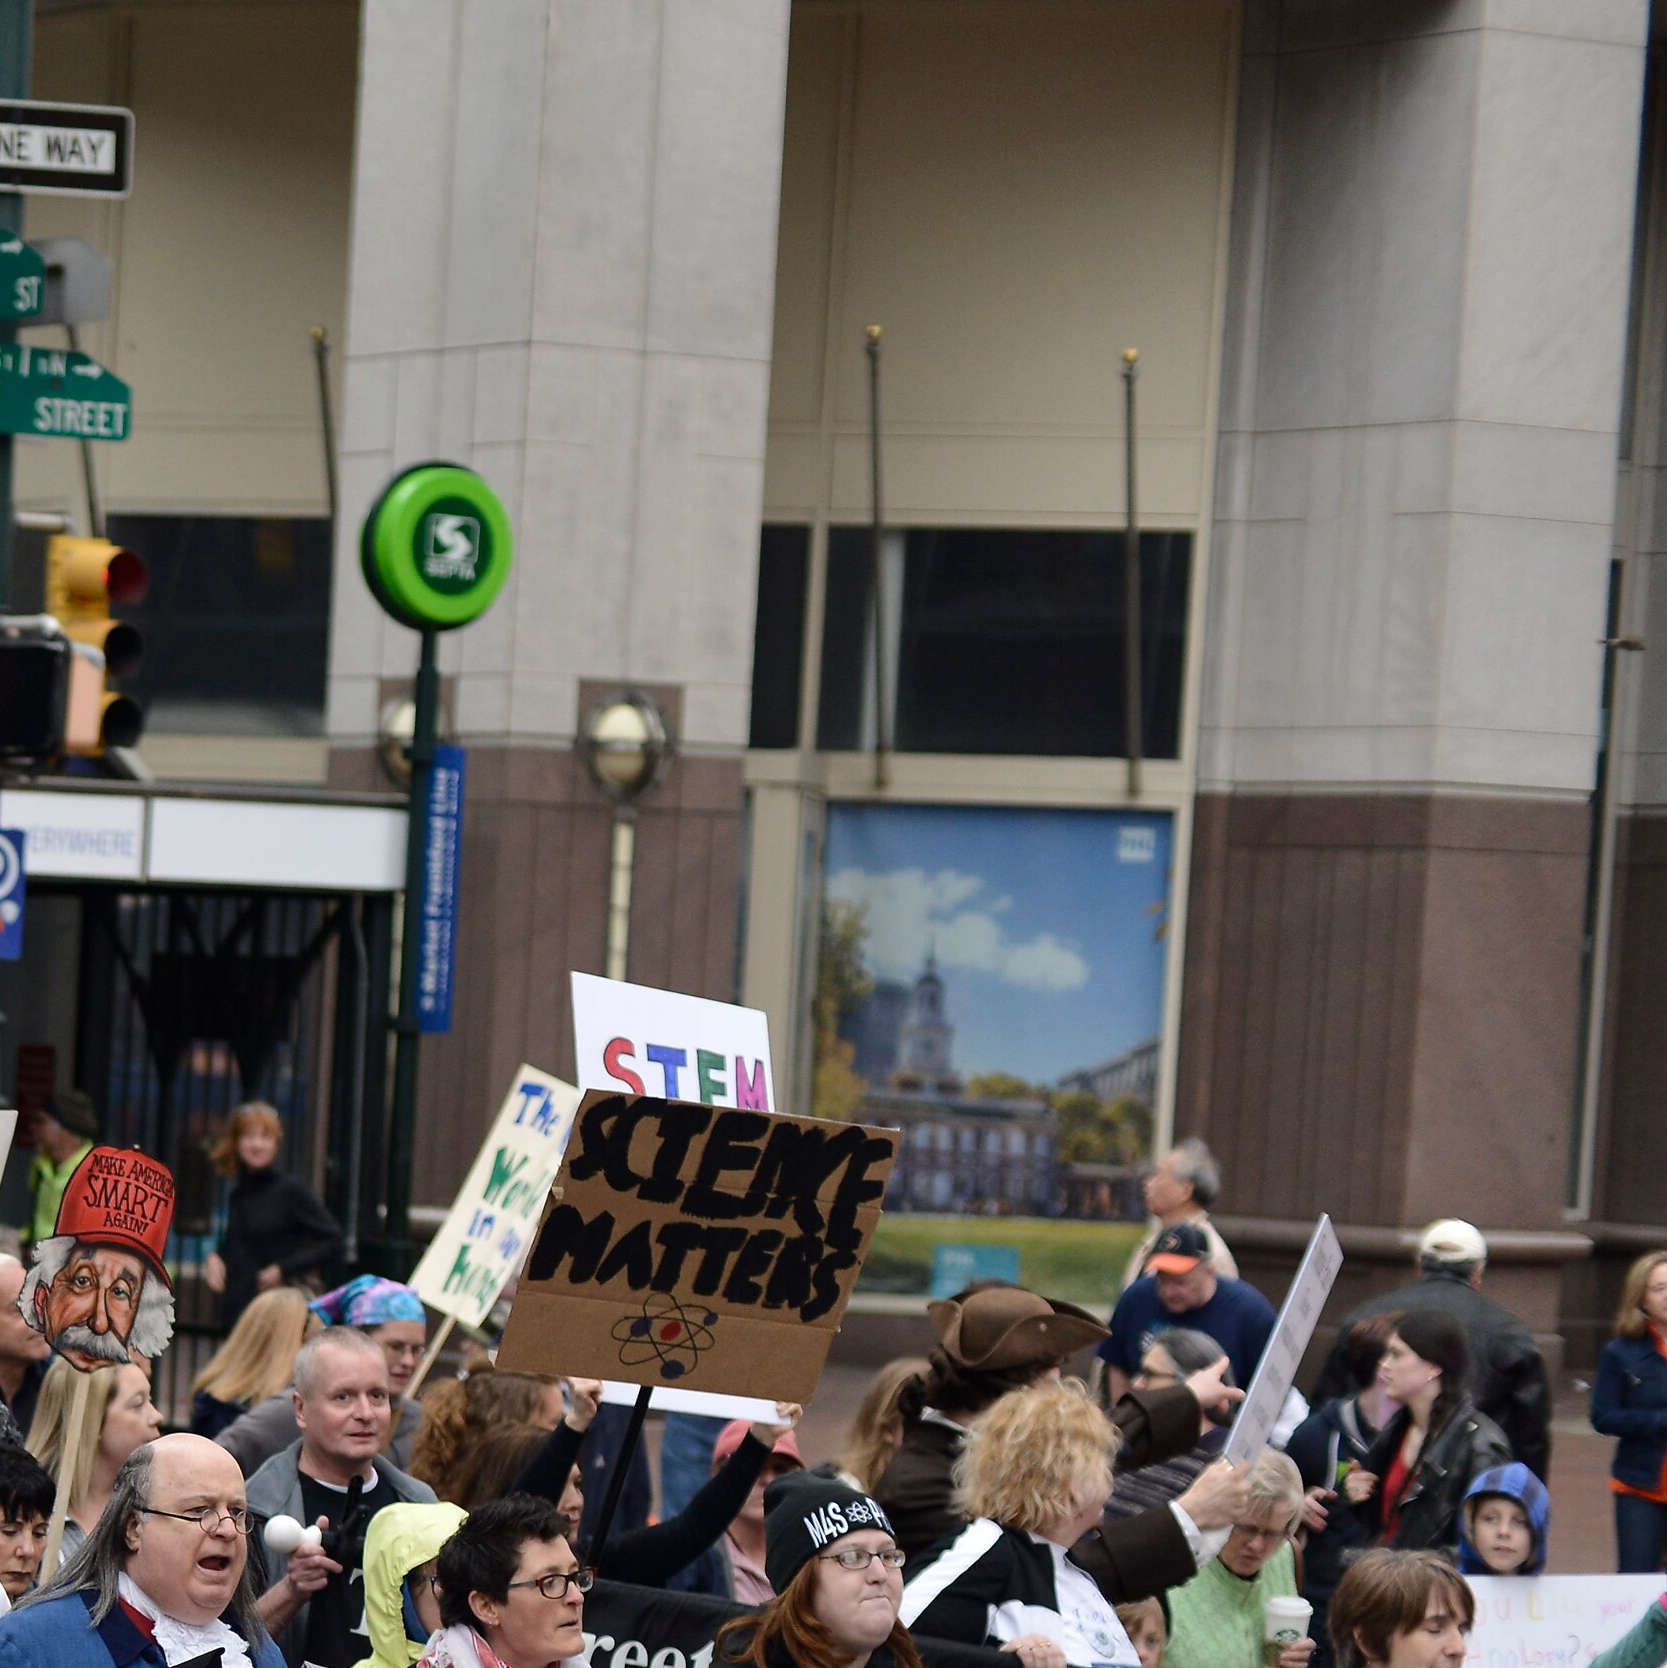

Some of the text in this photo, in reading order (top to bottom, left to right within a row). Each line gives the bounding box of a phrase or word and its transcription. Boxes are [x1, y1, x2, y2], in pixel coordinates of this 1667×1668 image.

[45, 133, 105, 168] WAY
[13, 276, 40, 311] ST
[33, 397, 127, 437] STREET
[514, 1082, 561, 1138] The
[88, 1153, 126, 1177] MAKE
[569, 1095, 894, 1246] SCIENCE
[83, 1173, 169, 1224] SMART
[103, 1211, 149, 1237] AGAIN!
[528, 1202, 860, 1322] MATTERS
[803, 1501, 849, 1549] M4S
